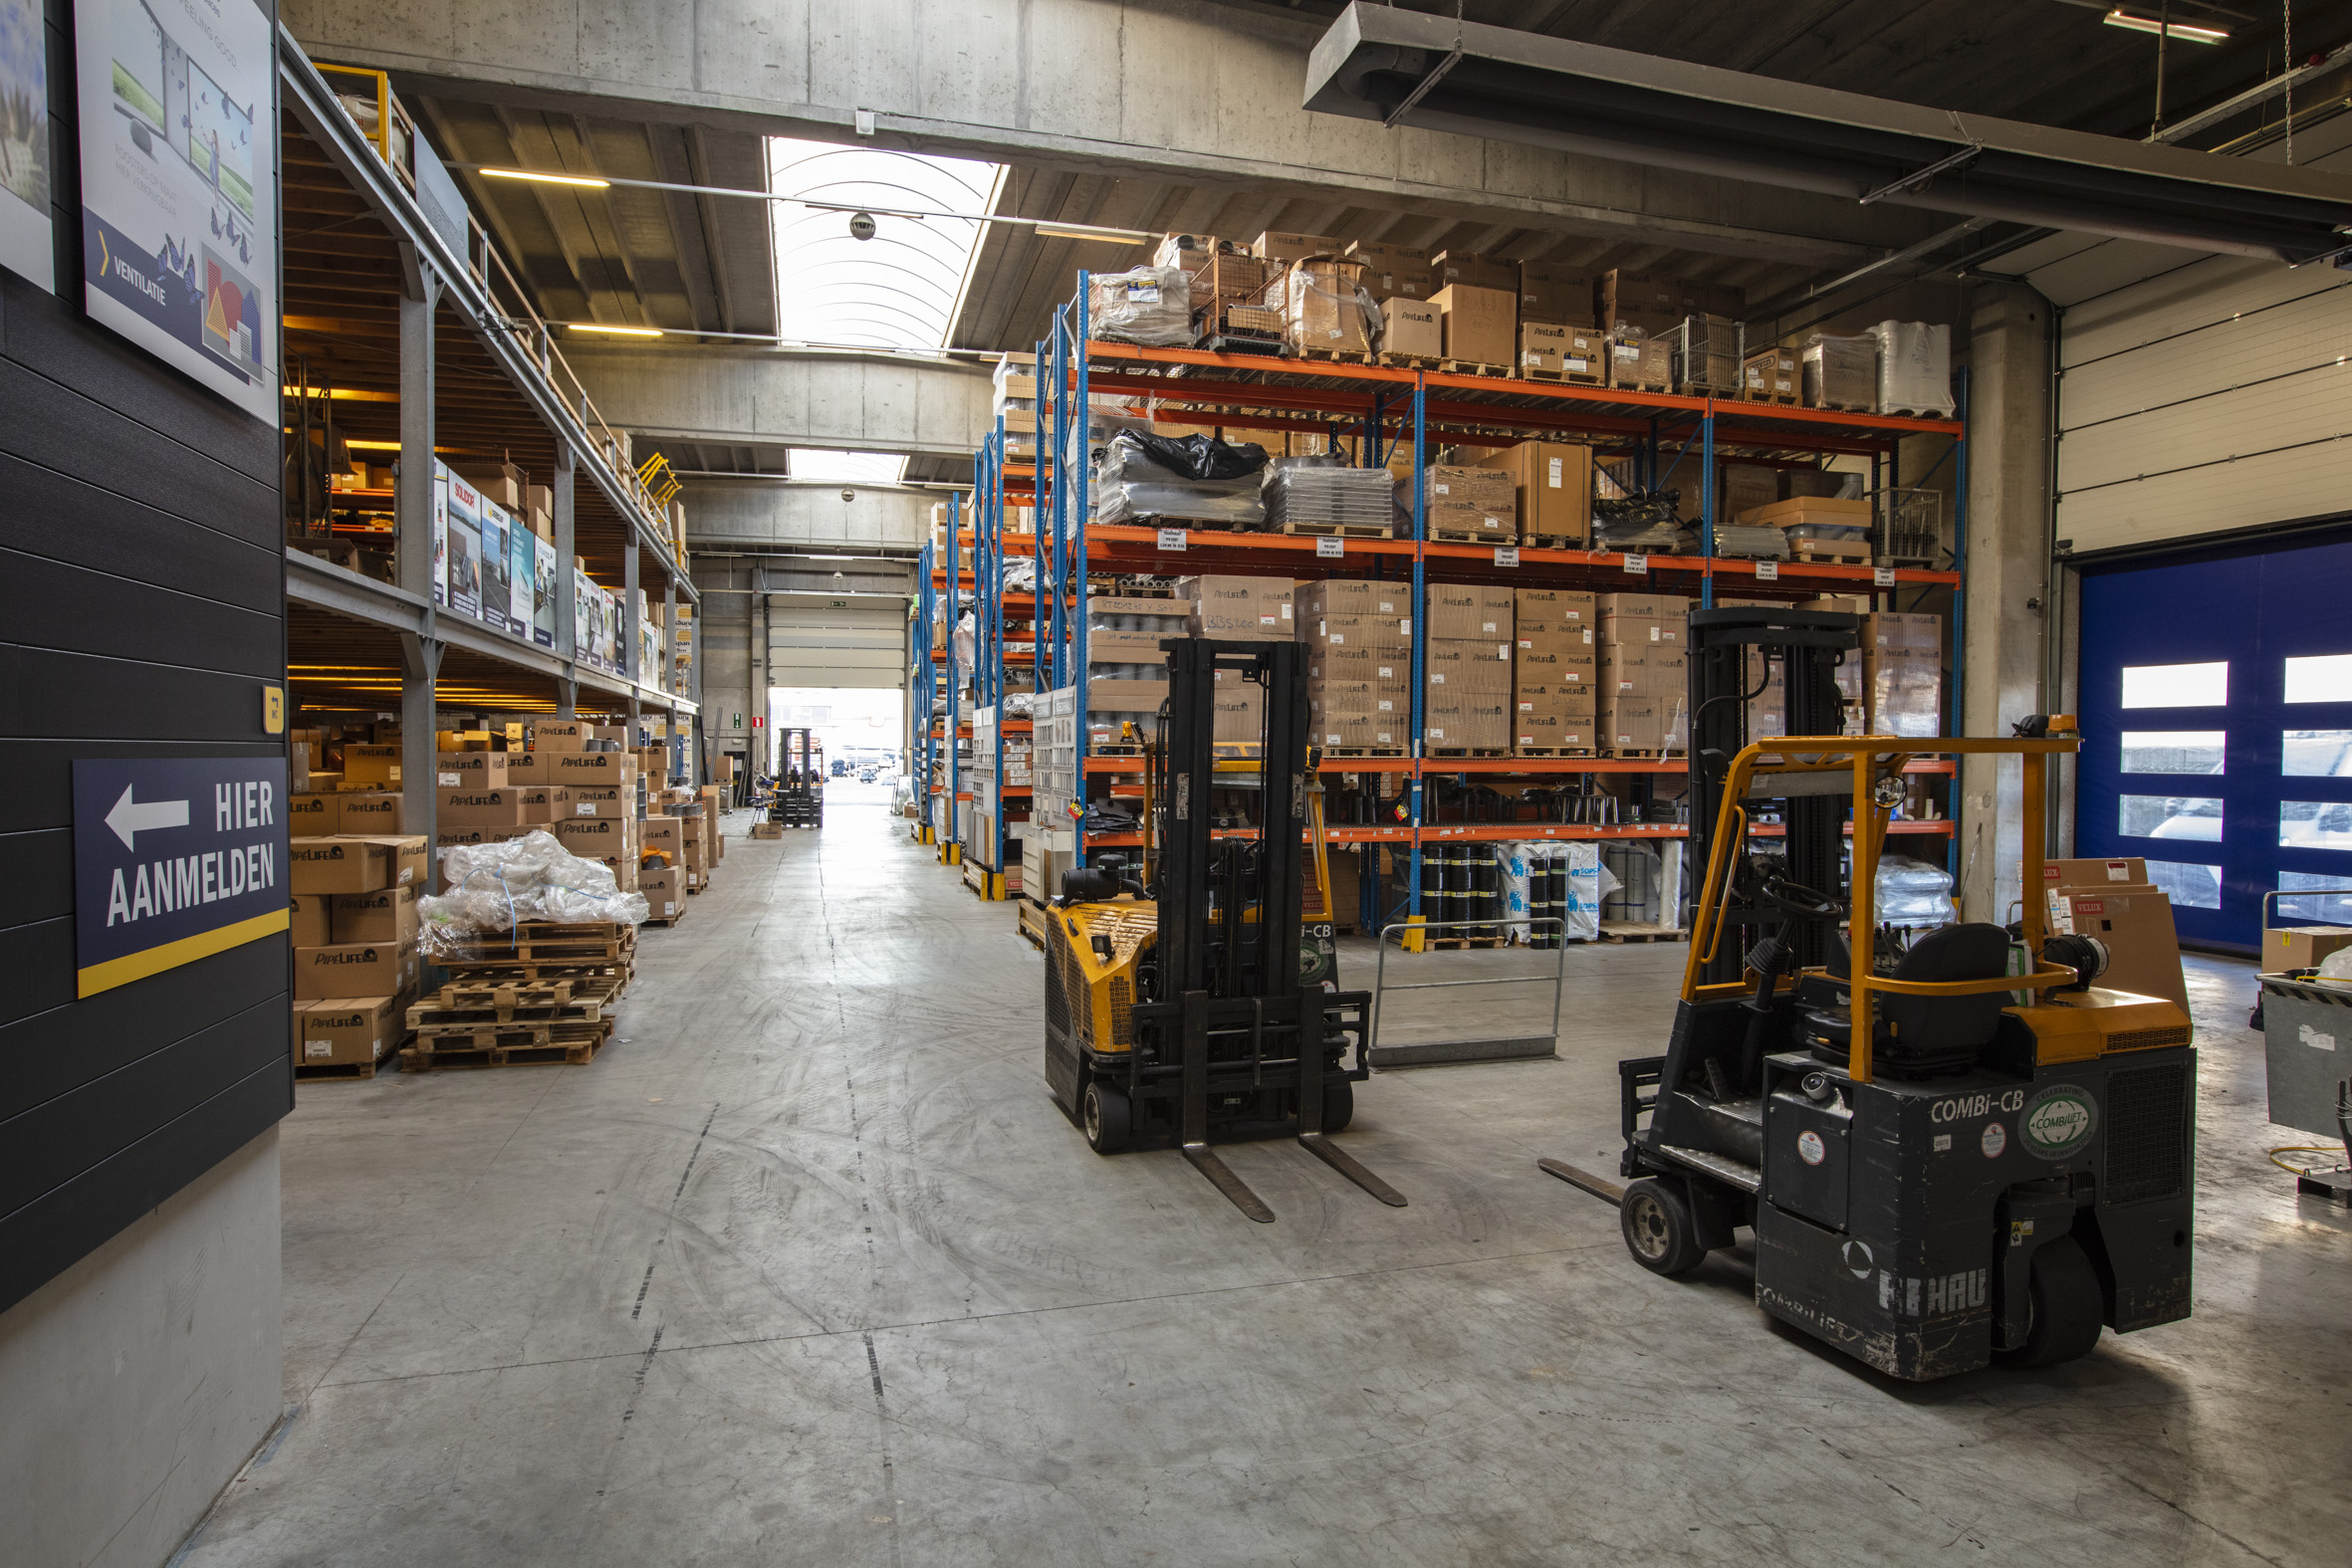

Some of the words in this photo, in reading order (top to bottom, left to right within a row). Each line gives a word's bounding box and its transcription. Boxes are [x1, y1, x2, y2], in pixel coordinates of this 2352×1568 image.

[115, 142, 149, 180] ROOSTERS
[115, 255, 166, 307] VENTILATIE
[454, 482, 475, 510] SOLIDOR
[216, 781, 274, 832] HIER
[107, 842, 275, 928] AANMELDEN
[2043, 868, 2058, 877] LUX
[2076, 903, 2102, 912] VELUX
[1301, 925, 1331, 938] i-CB
[1930, 1089, 2024, 1124] COMBi-CB
[2036, 1086, 2084, 1102] CELEBRATING
[2057, 1130, 2093, 1156] INNOVATION
